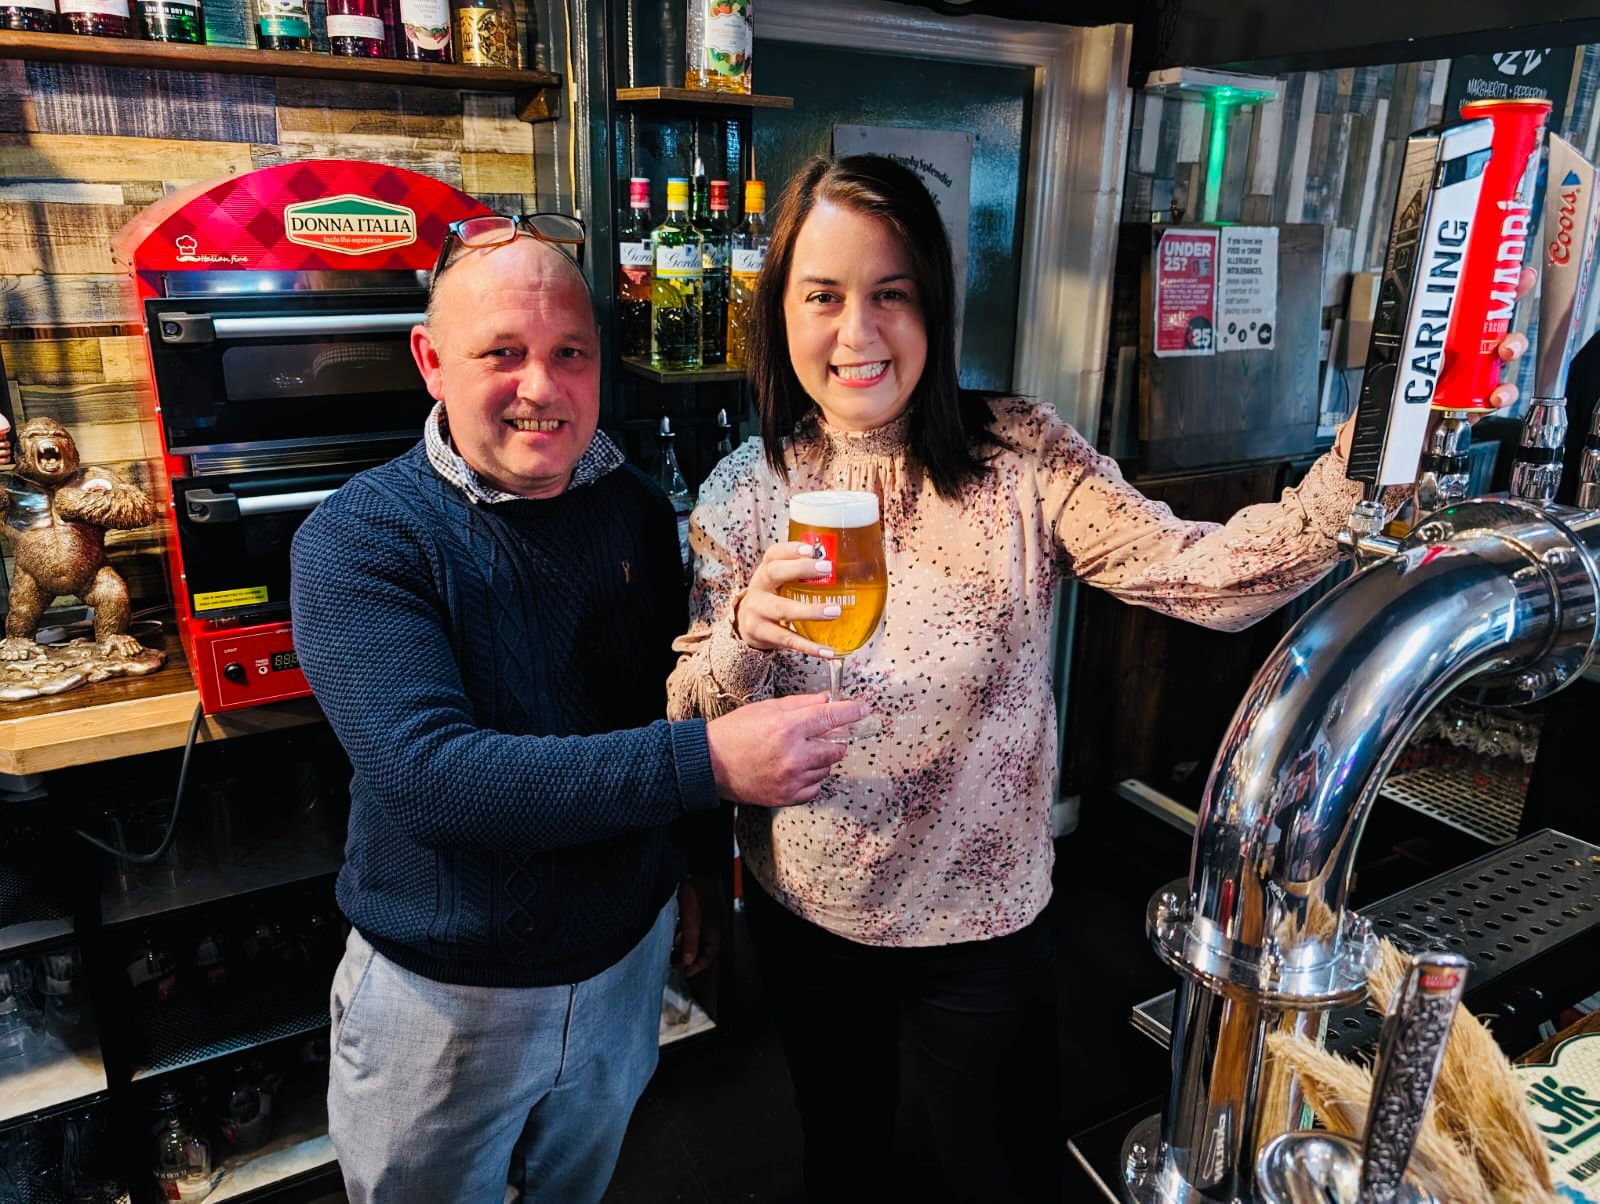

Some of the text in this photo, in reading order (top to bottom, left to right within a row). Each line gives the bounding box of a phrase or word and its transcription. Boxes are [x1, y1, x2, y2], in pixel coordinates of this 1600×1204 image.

[1467, 78, 1508, 97] MARGHERITA
[291, 217, 412, 233] DONNA ITALIA
[1548, 191, 1577, 267] Coors
[1165, 241, 1211, 257] UNDER
[1164, 257, 1188, 272] 25?
[1404, 220, 1469, 404] CARLING
[1193, 328, 1211, 347] 25
[825, 594, 856, 608] MADRID
